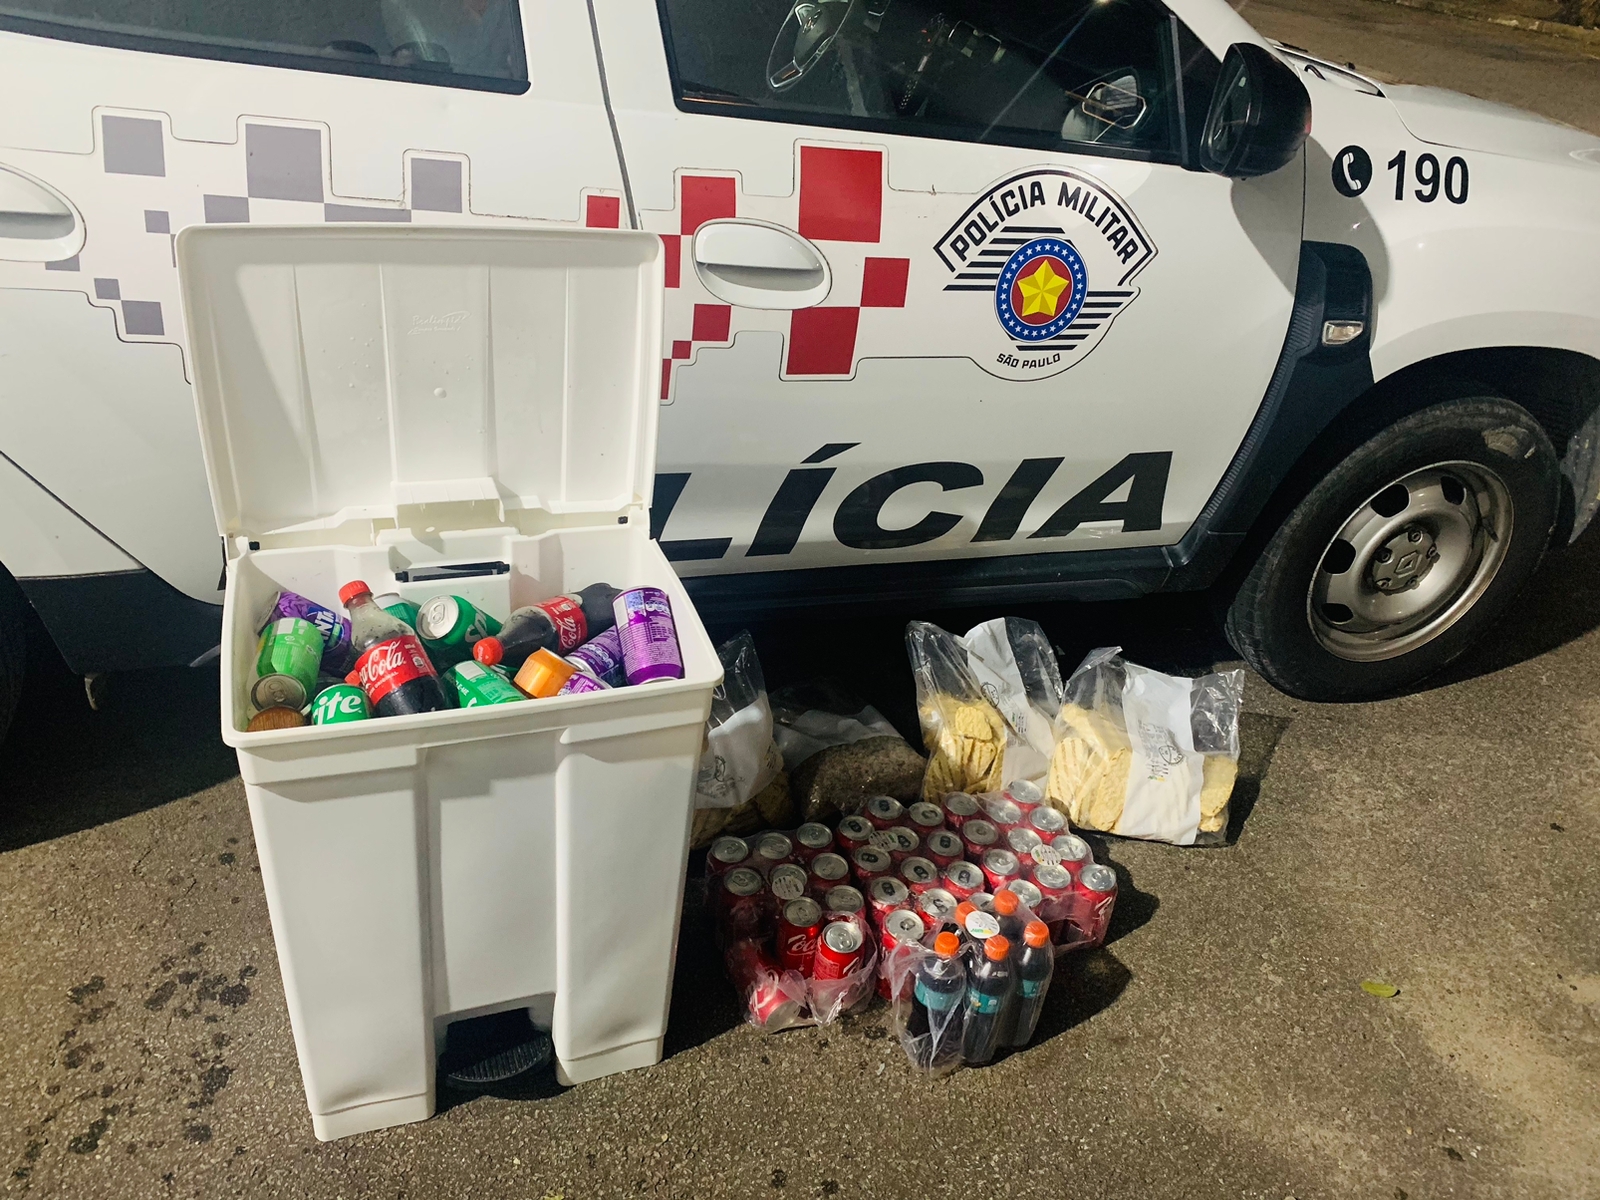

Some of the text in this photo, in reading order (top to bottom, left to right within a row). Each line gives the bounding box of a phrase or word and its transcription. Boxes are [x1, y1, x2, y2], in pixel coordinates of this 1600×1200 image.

[1387, 150, 1469, 204] 190
[950, 181, 1139, 265] POLÍCIA MILITAR
[996, 353, 1061, 369] SÃO PAULO
[651, 442, 1173, 562] LÍCIA
